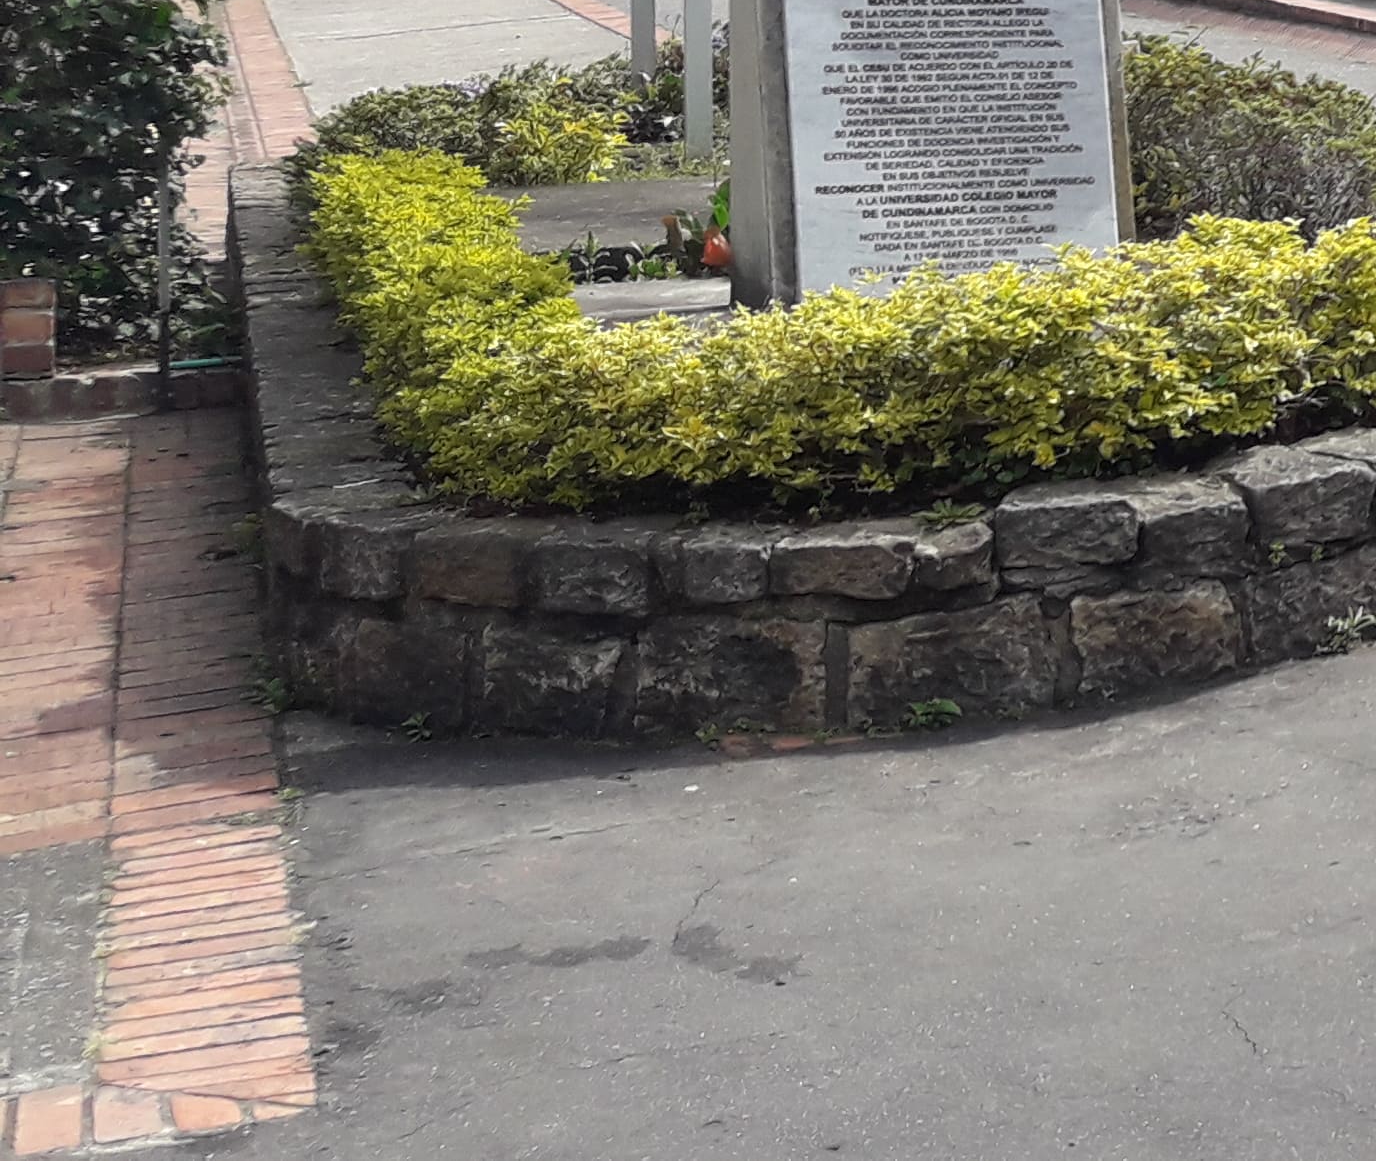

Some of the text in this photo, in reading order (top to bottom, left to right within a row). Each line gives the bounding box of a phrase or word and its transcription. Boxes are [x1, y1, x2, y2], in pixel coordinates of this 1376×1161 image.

[814, 184, 884, 195] RECONOCER
[880, 193, 959, 206] UNIVERSIDAD
[962, 191, 1014, 202] COLEGIO
[1016, 189, 1058, 200] MAYOR
[862, 209, 879, 219] DE
[882, 205, 977, 218] CUNDINAMARCA
